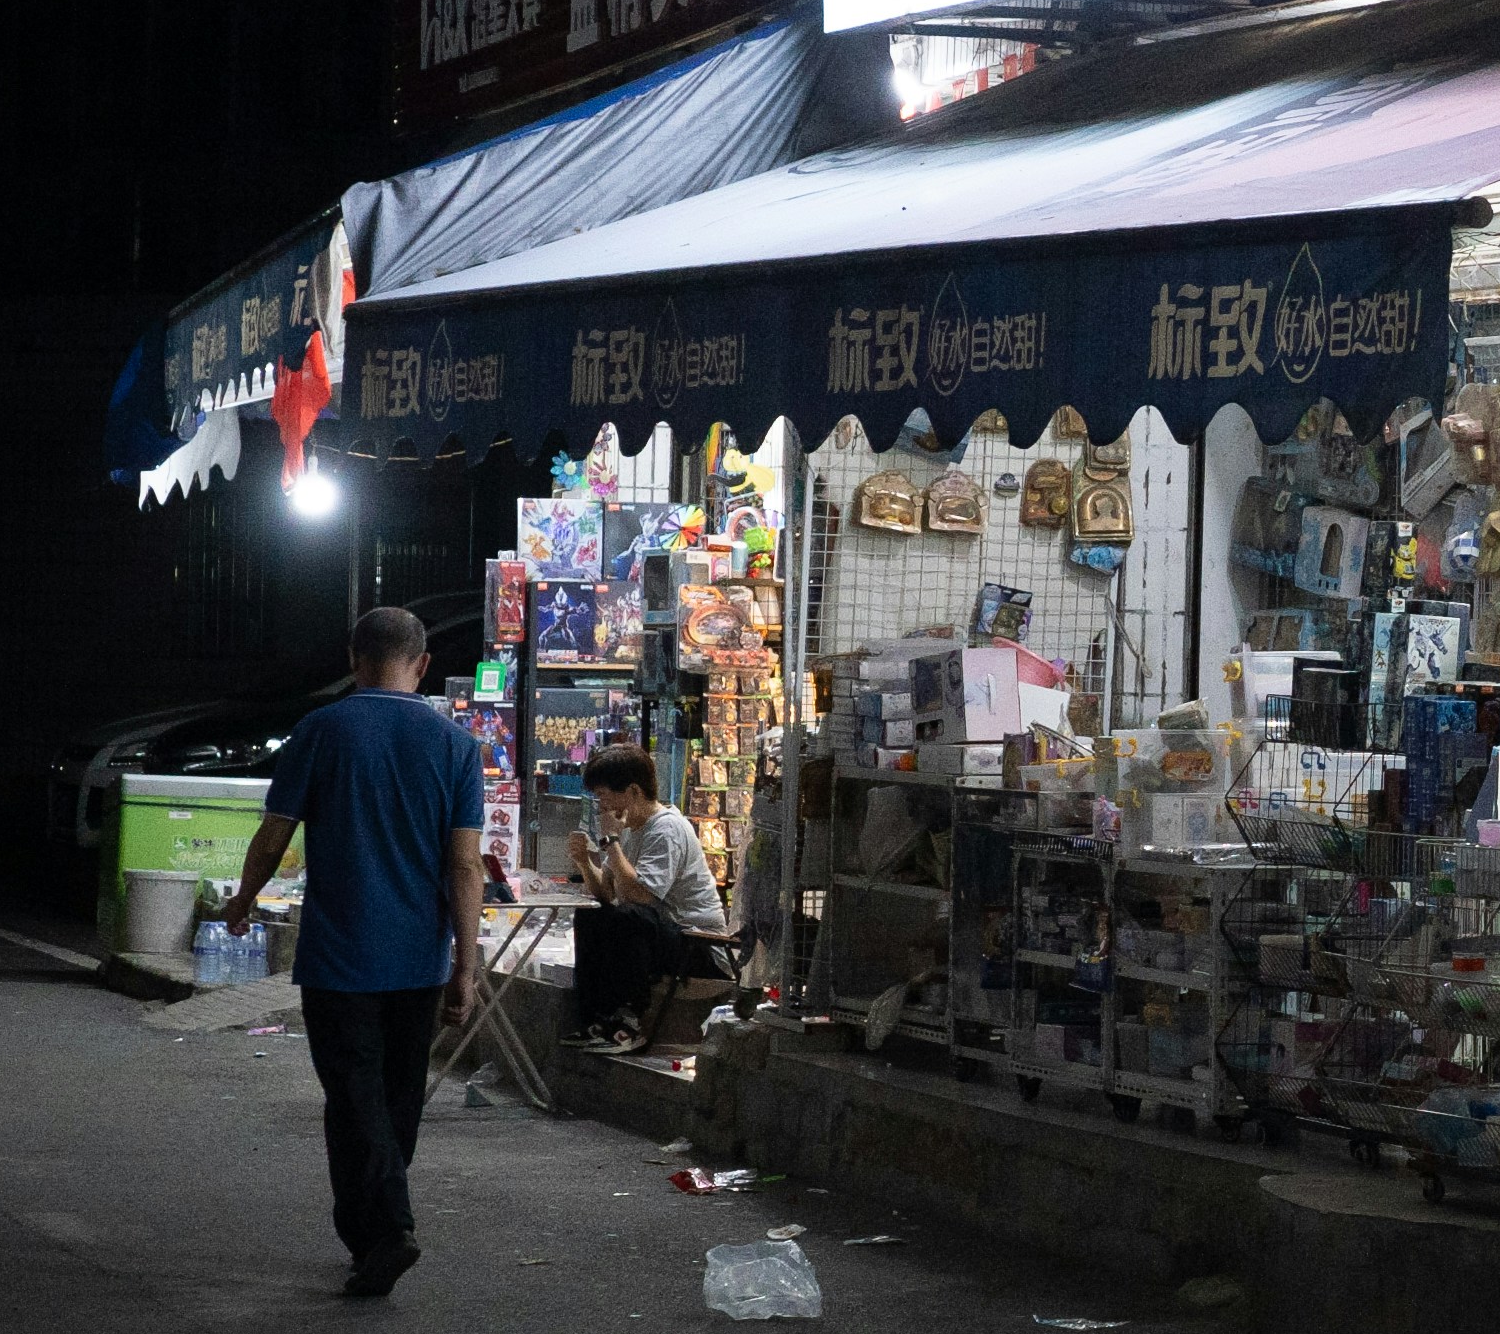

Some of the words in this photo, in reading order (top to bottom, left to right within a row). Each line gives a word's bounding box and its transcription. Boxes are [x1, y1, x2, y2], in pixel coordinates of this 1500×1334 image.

[571, 329, 645, 406] 标致
[826, 306, 920, 394] 标致
[929, 329, 966, 376] 好水
[1148, 278, 1266, 380] 标致
[1272, 299, 1325, 359] 好水
[361, 346, 421, 420] 标致
